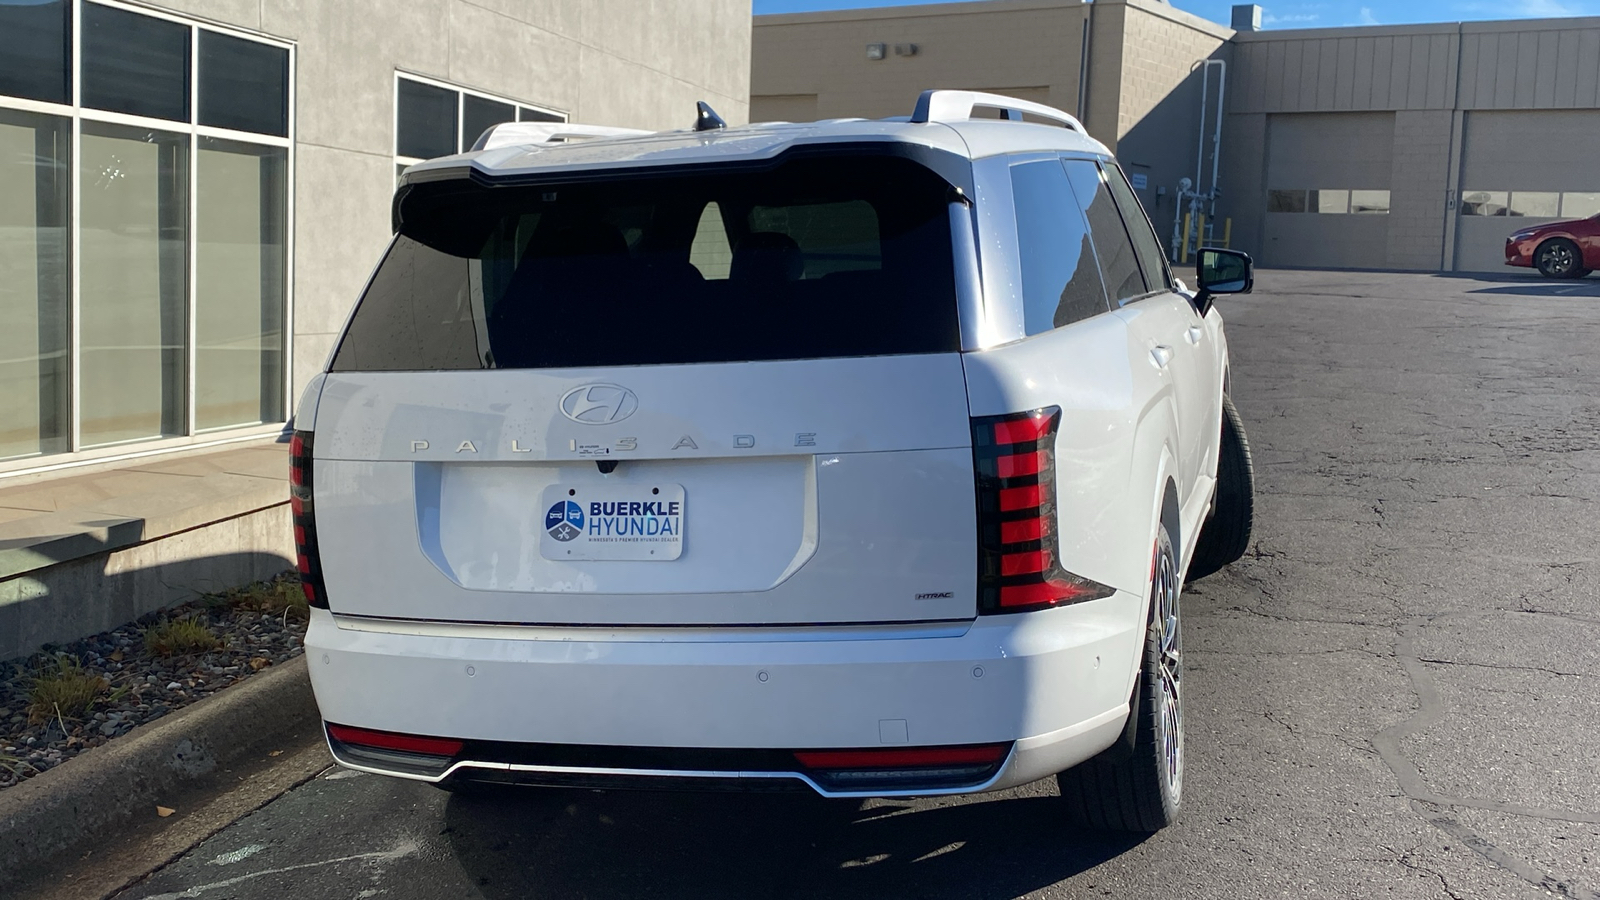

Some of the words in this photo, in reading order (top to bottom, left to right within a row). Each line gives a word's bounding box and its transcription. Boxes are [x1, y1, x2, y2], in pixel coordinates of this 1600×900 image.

[410, 432, 817, 453] PALISADE
[590, 502, 680, 516] BUERKLE
[589, 517, 679, 536] HYUNDAI
